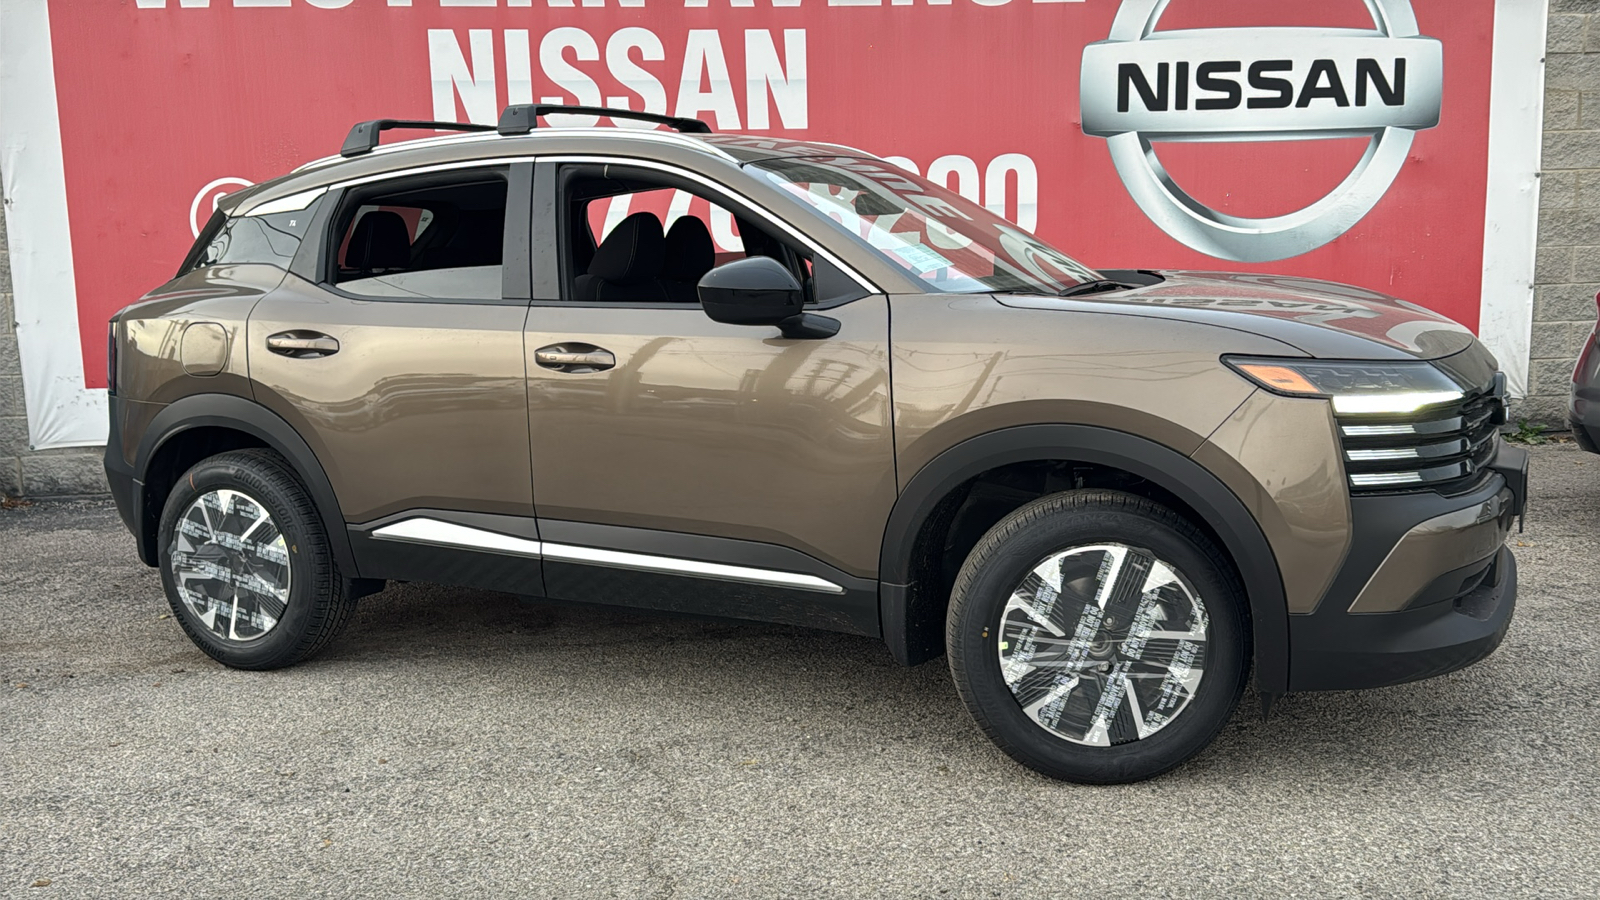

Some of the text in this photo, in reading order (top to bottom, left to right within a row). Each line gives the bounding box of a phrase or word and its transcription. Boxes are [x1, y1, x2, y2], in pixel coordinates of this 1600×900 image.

[427, 27, 808, 131] NISSAN
[1117, 58, 1406, 113] NISSAN
[233, 467, 297, 532] BRIDGESTONE
